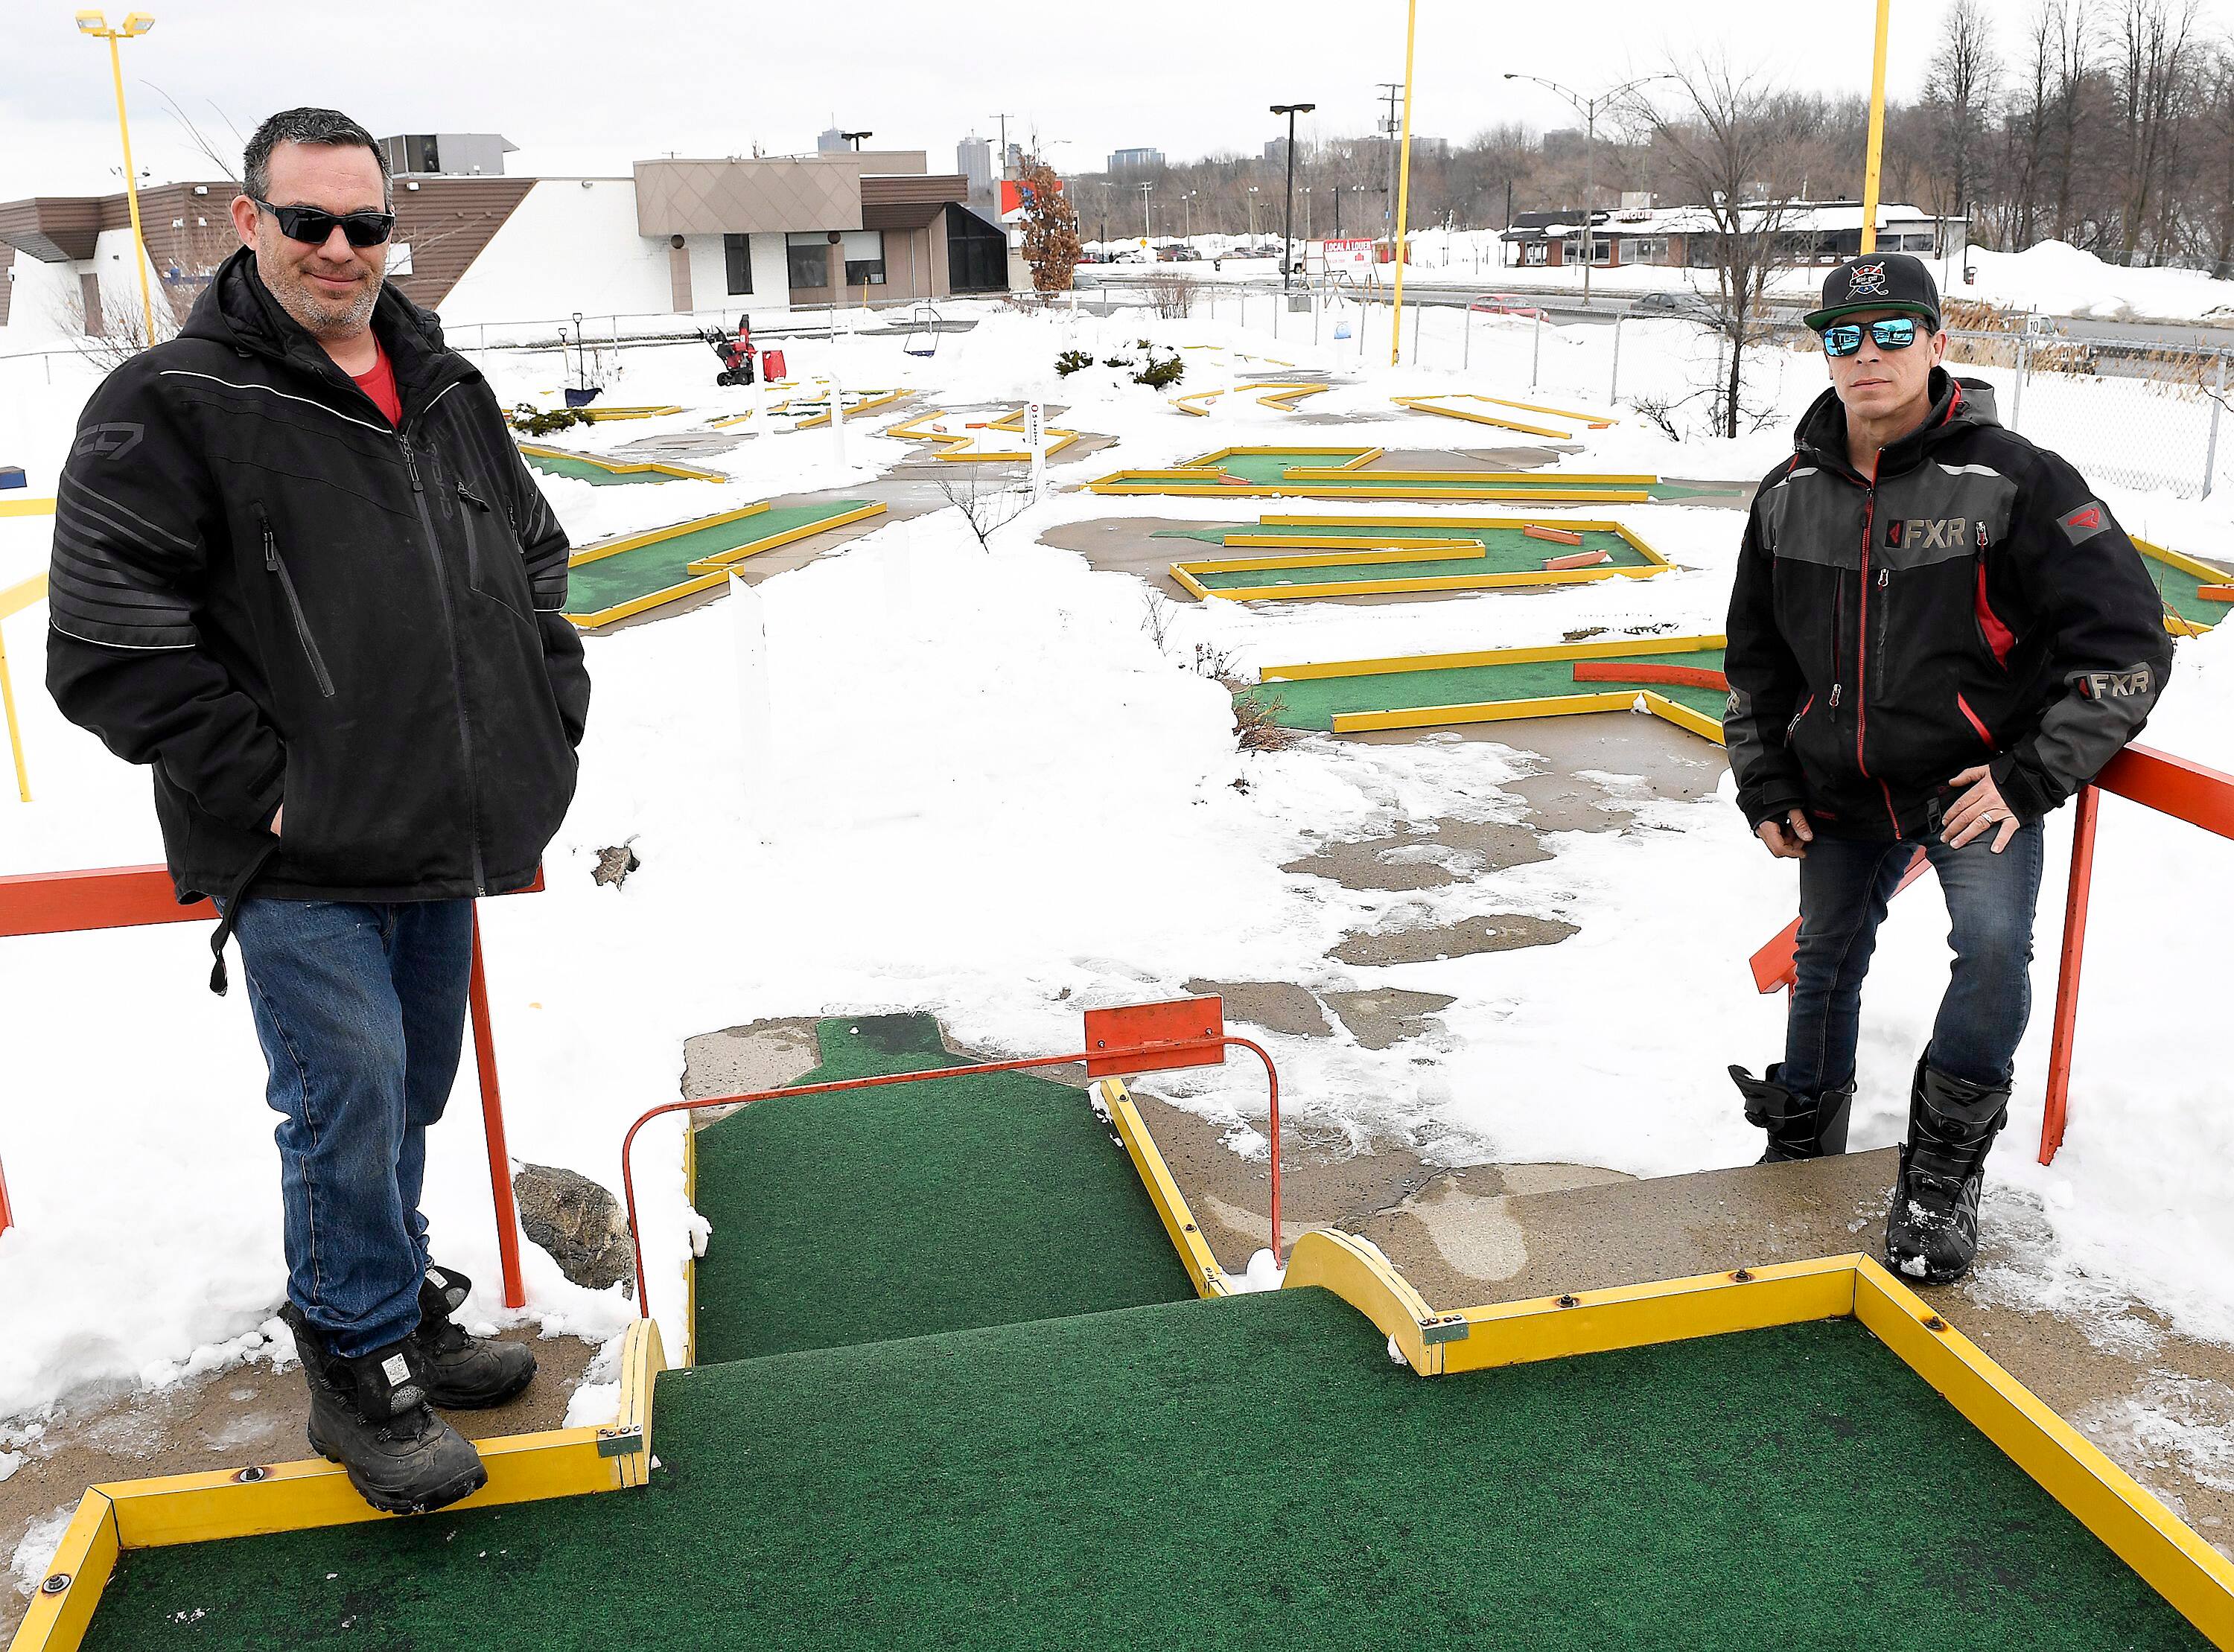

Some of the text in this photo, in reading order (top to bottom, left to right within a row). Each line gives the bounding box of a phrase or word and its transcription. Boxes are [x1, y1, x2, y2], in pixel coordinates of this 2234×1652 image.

[1326, 242, 1345, 252] LOCAL
[1352, 240, 1371, 251] LOUER
[2030, 321, 2039, 332] 10
[1904, 517, 1966, 549] FXR
[2090, 671, 2149, 699] FXR
